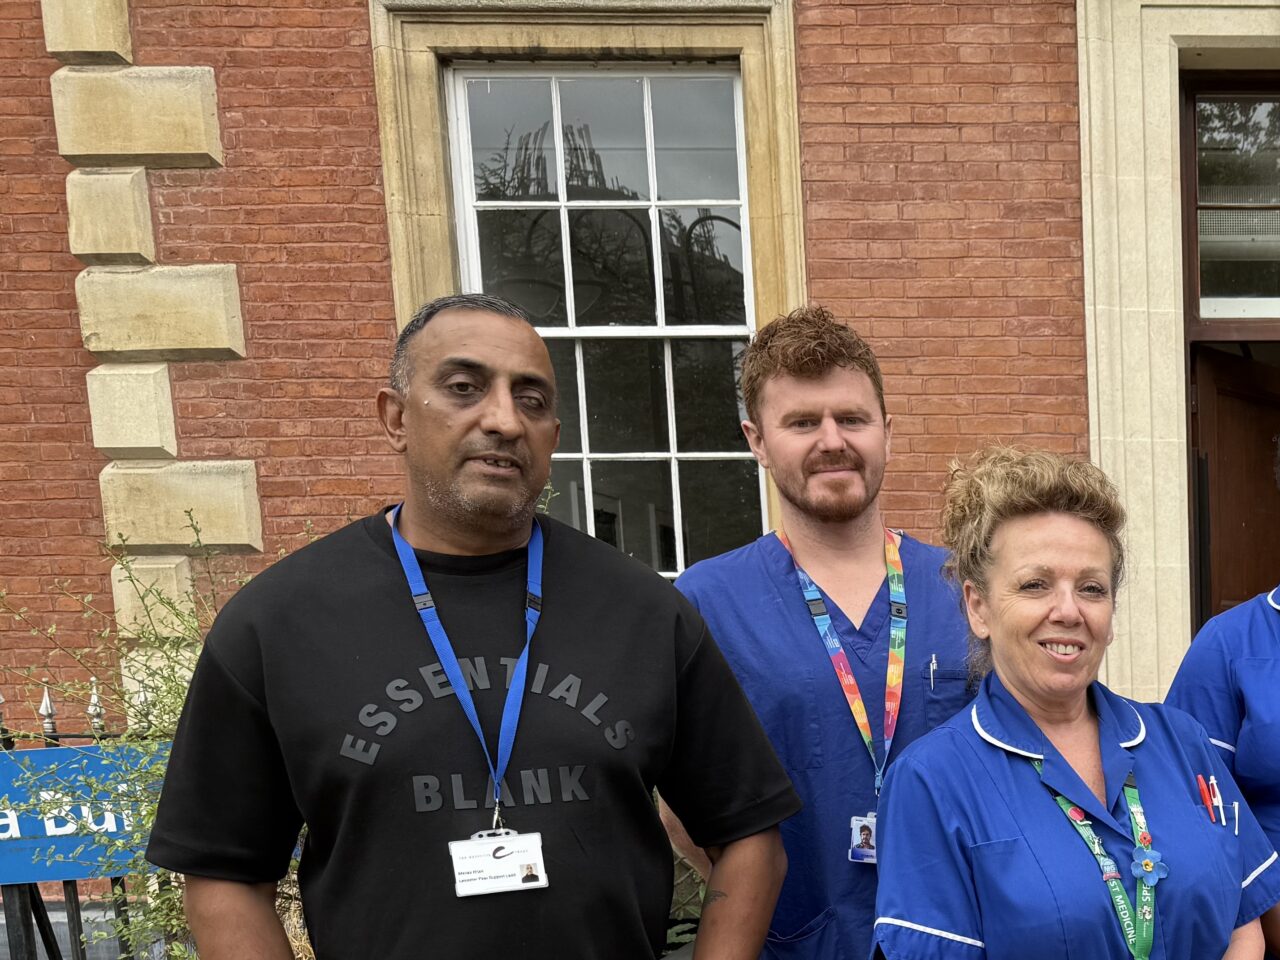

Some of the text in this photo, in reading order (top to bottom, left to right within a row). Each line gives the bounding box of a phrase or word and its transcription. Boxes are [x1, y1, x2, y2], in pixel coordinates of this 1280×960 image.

[339, 656, 636, 766] ESSENTIALS
[412, 765, 590, 812] BLANK
[1115, 895, 1137, 945] MEDICINE
